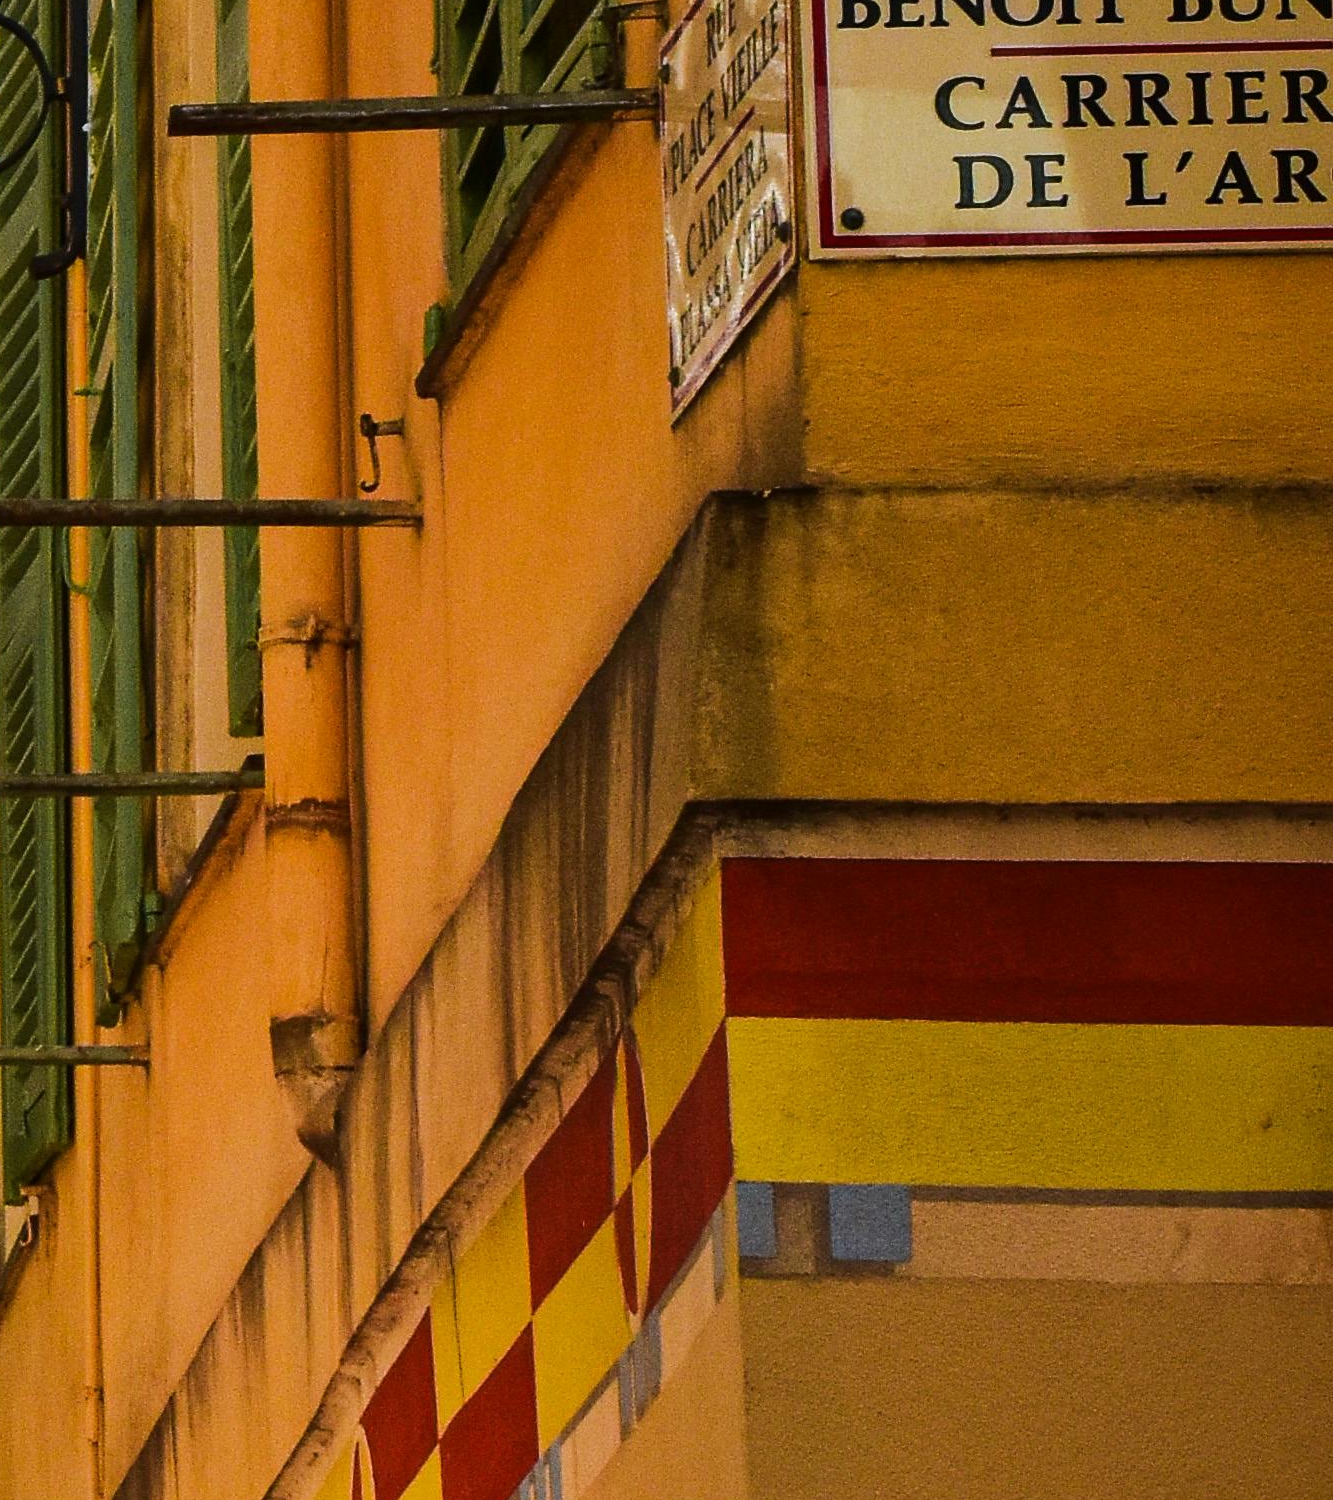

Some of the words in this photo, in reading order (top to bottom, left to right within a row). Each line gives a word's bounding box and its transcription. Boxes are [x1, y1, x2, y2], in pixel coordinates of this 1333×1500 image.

[670, 87, 716, 196] PLACE
[720, 0, 780, 122] VIEILLE
[934, 69, 1333, 131] CARRIER
[685, 124, 769, 280] CARRIERA
[952, 152, 1070, 210] DE
[1122, 149, 1333, 207] L'AR
